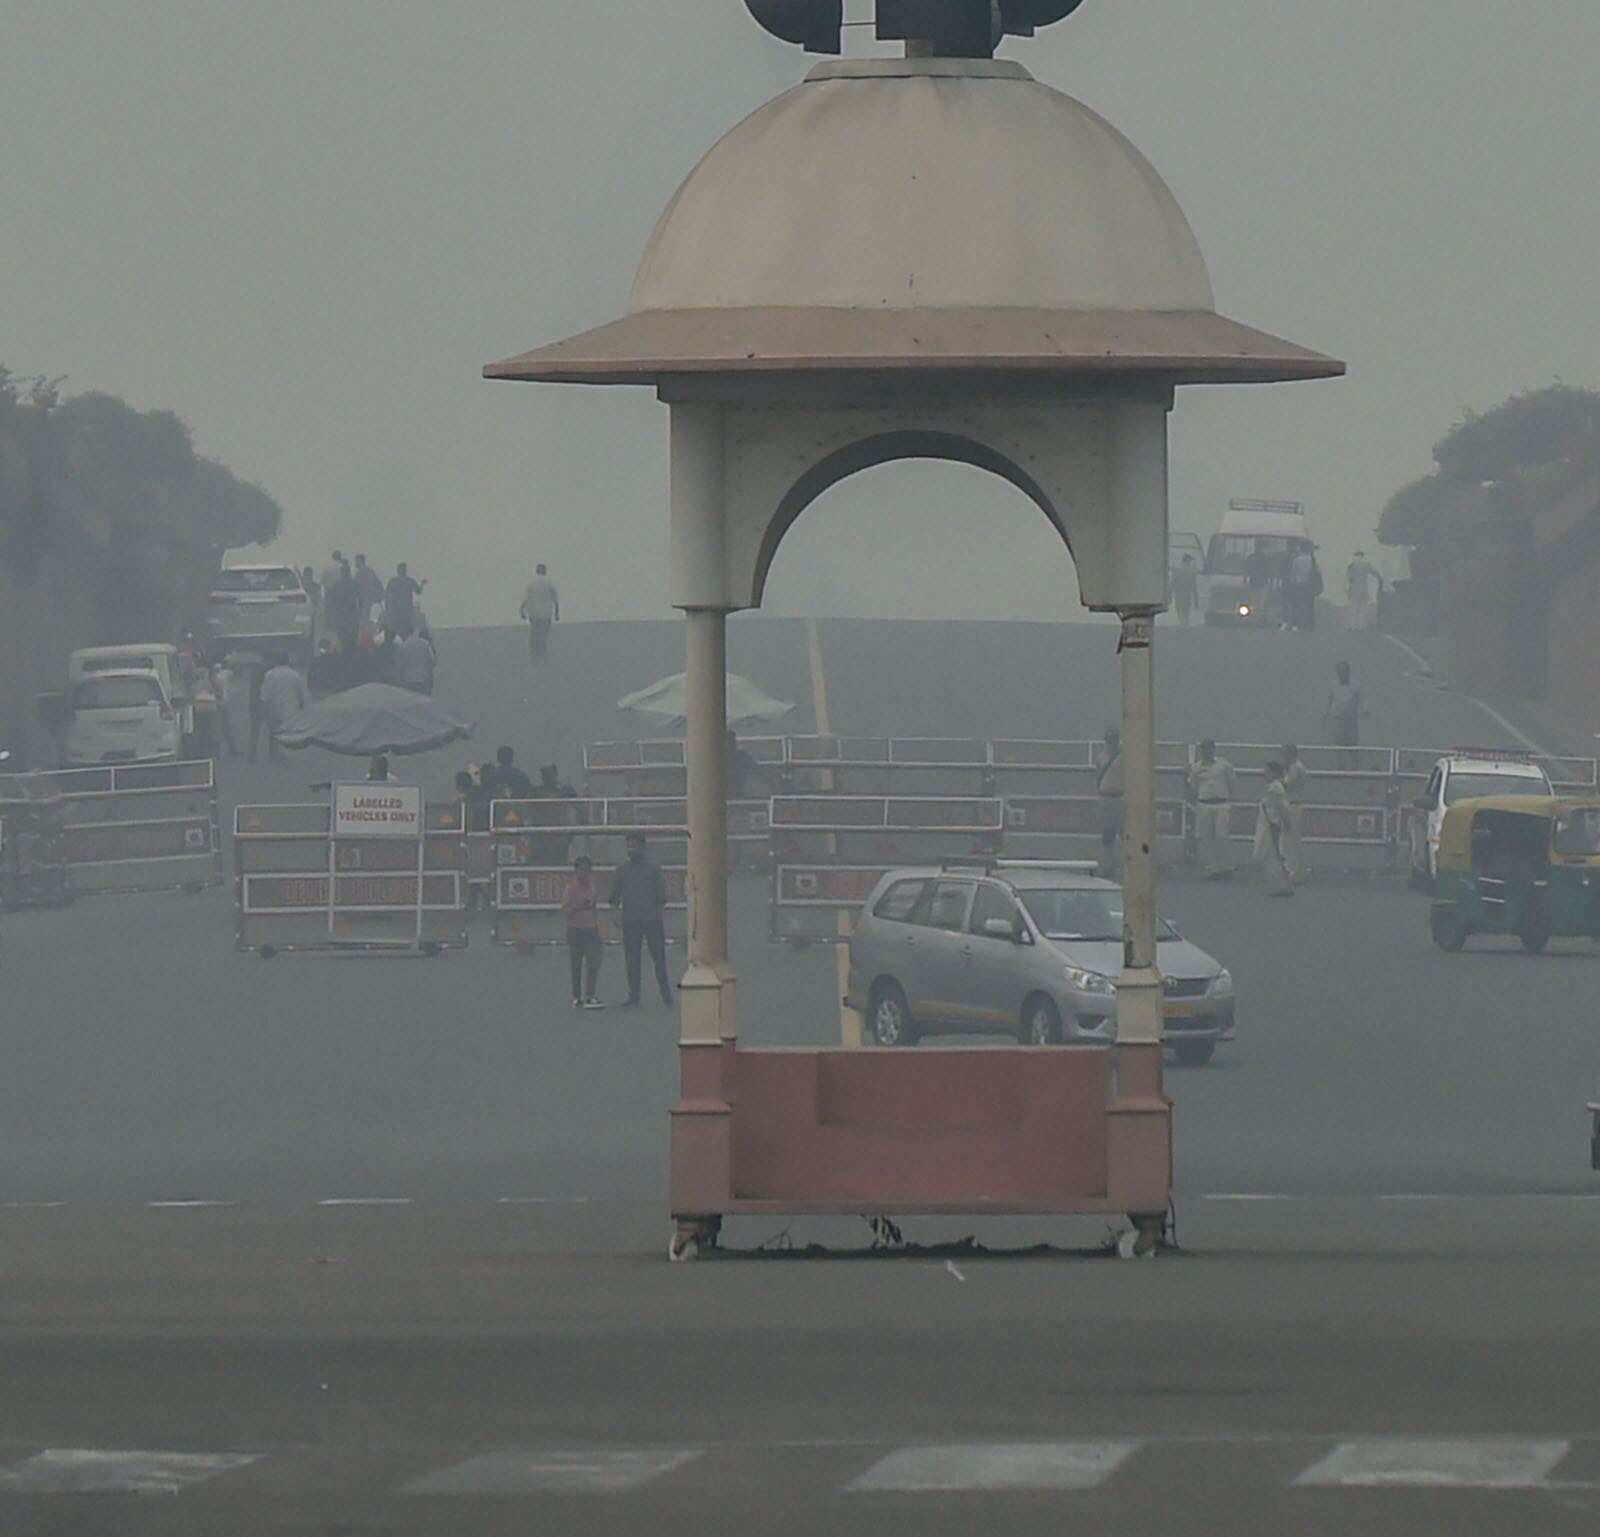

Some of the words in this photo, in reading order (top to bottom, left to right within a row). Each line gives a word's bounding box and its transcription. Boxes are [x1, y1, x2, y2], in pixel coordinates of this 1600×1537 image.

[353, 798, 403, 809] LABELLED
[339, 810, 388, 822] VEHICLES
[390, 811, 417, 822] ONLY
